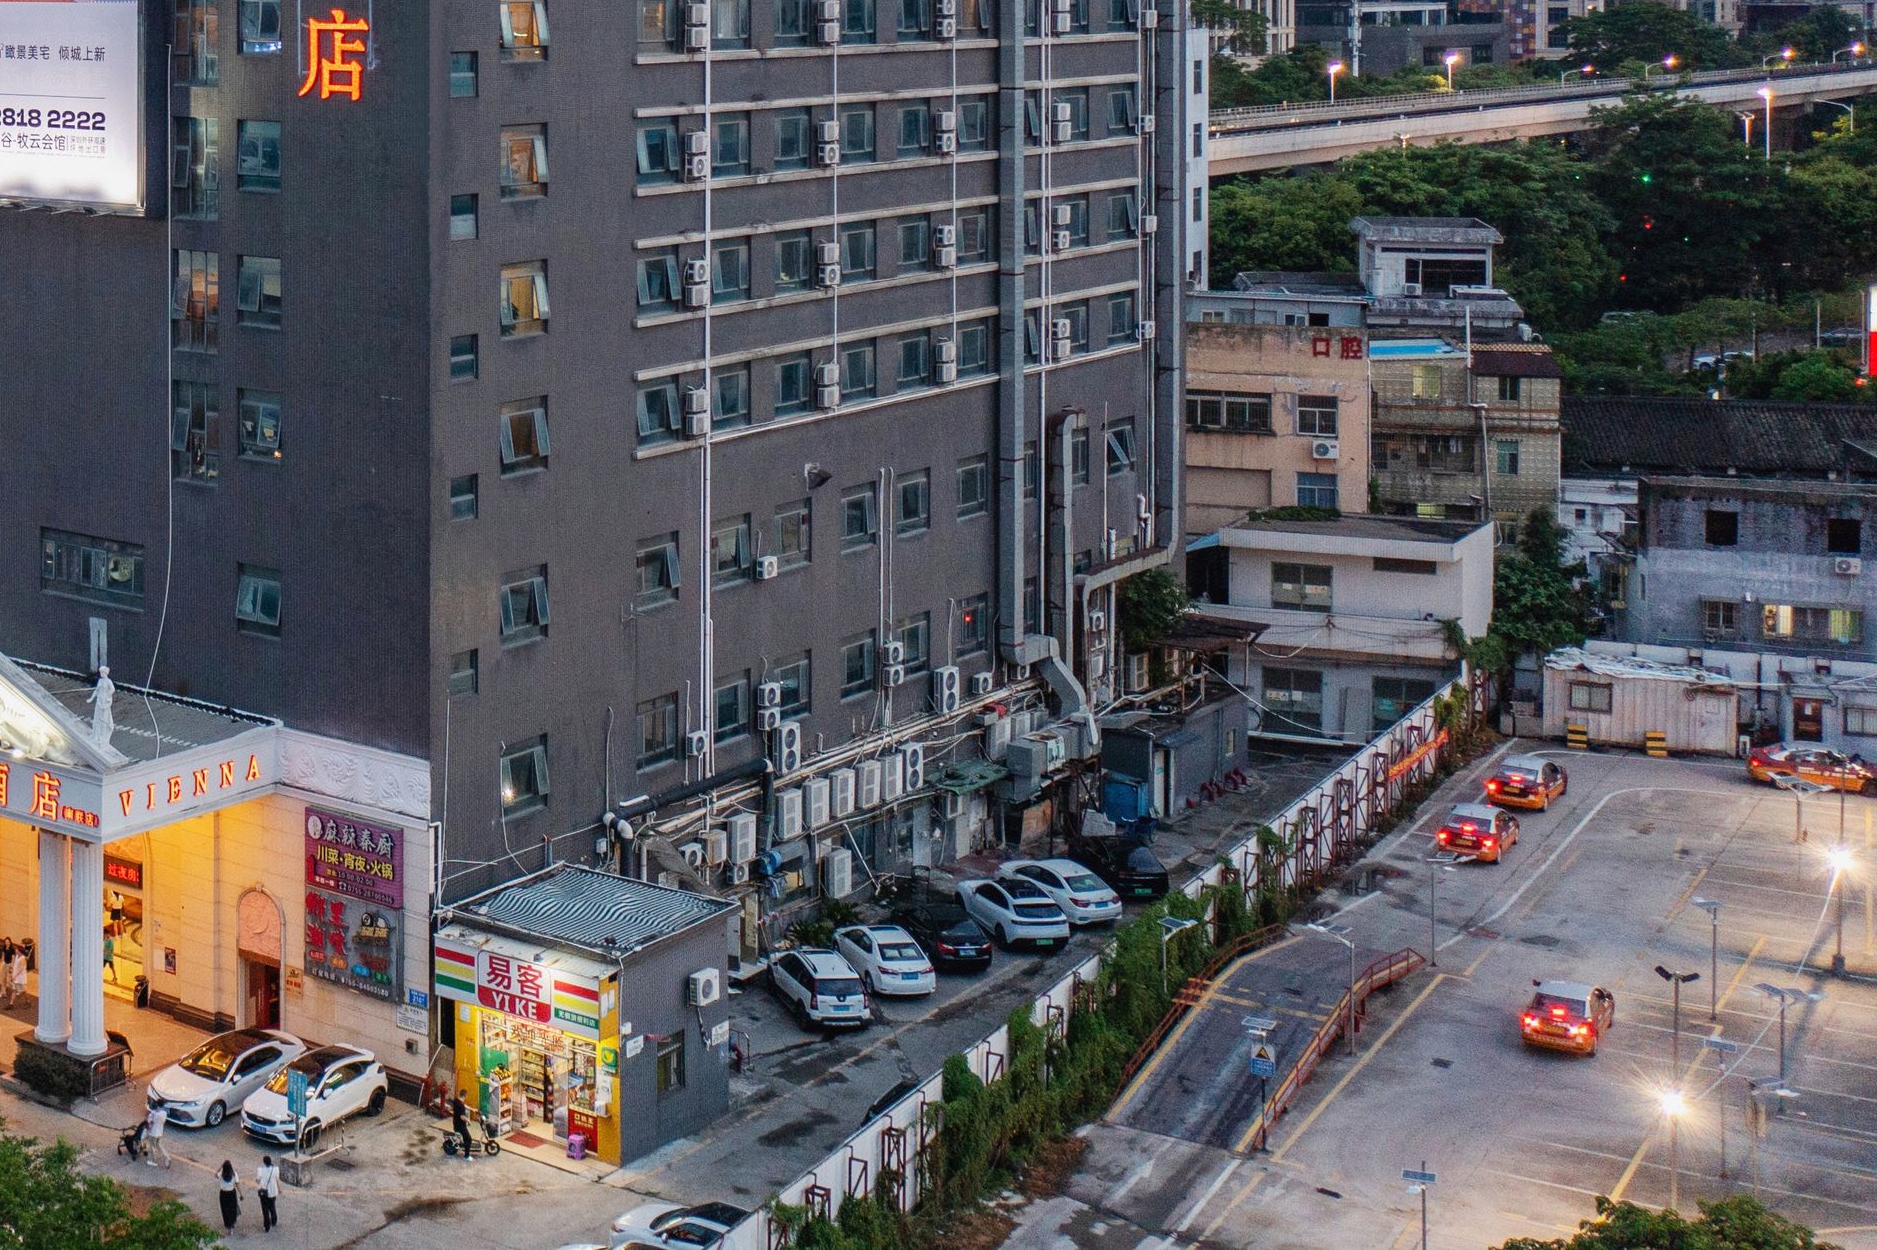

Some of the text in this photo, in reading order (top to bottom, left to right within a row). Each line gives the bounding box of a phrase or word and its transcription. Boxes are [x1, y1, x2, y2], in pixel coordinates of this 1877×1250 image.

[47, 109, 106, 131] 2222
[119, 754, 261, 817] VIENNA
[486, 955, 543, 1000] 易客
[491, 991, 538, 1021] YI KE
